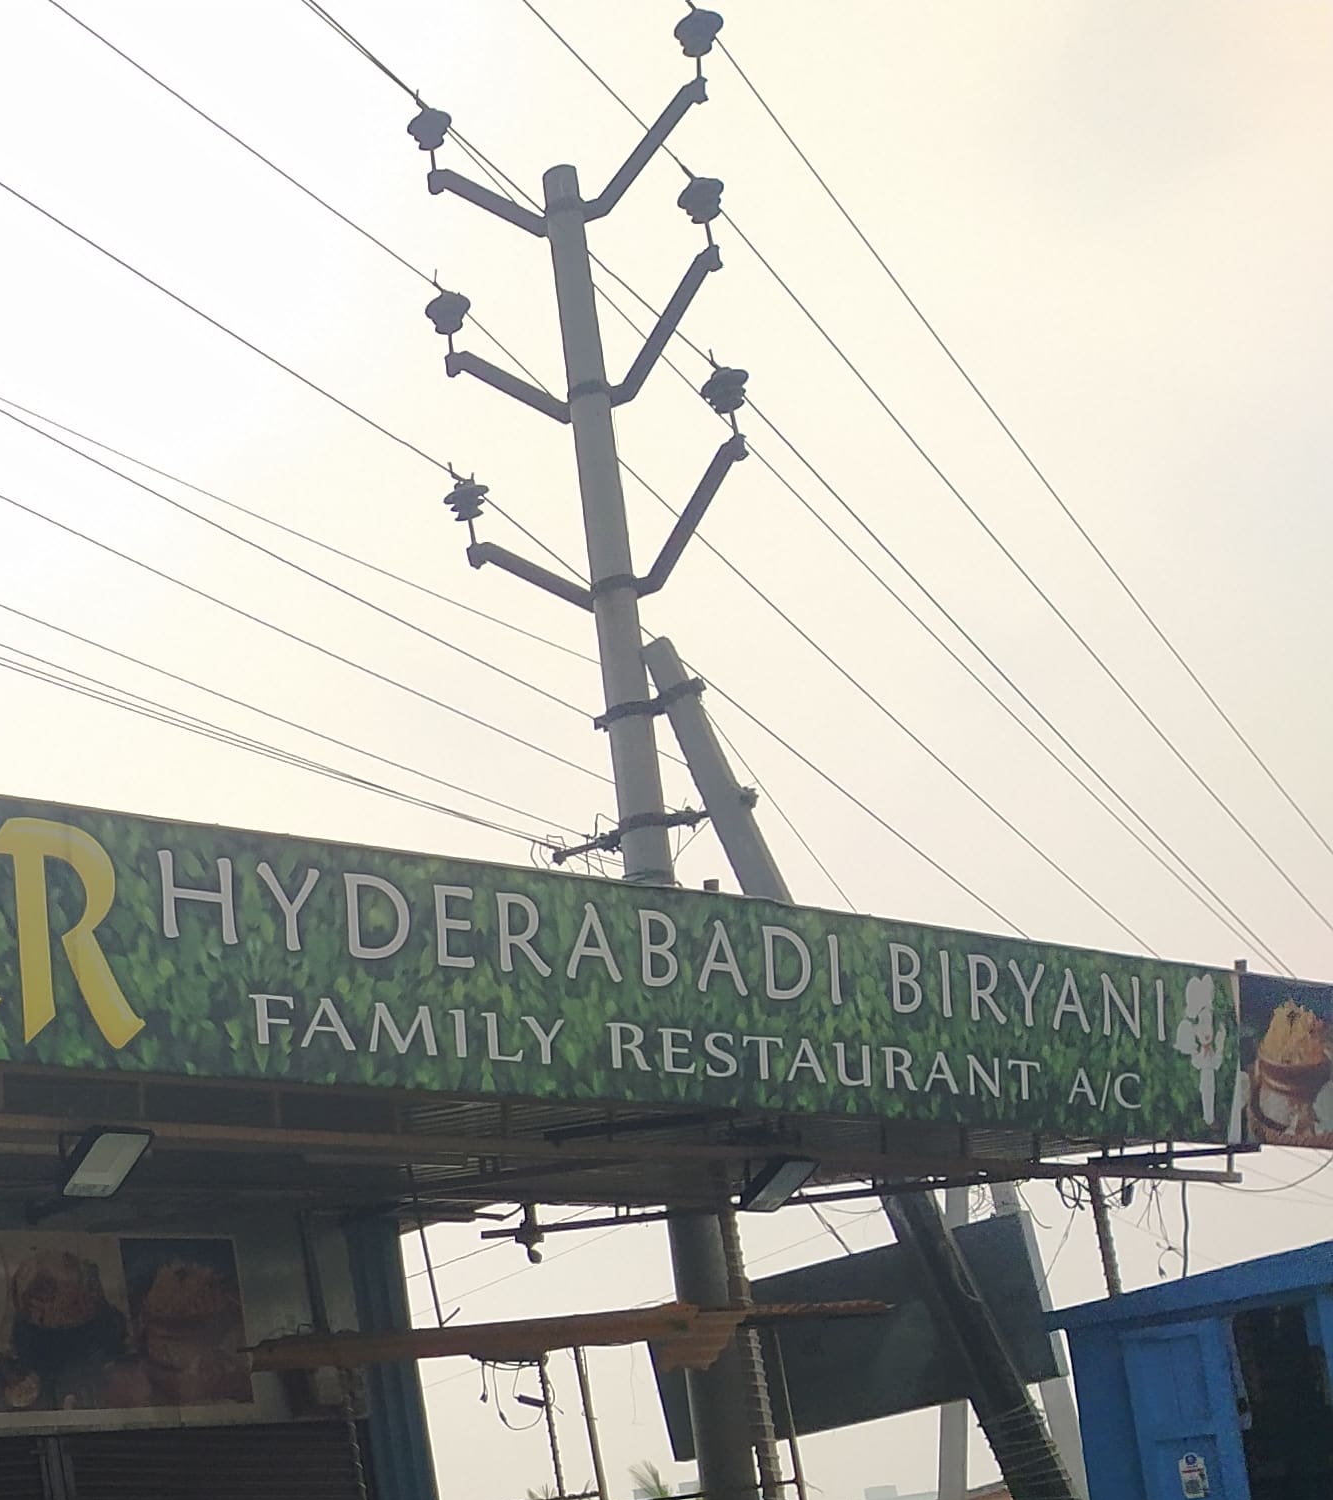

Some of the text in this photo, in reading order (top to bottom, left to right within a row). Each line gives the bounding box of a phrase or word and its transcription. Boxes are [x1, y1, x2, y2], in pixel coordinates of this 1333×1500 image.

[156, 849, 1166, 1042] HYDERABADI BIRYANI
[248, 994, 1142, 1111] FAMILY RESTAURANT A/C
